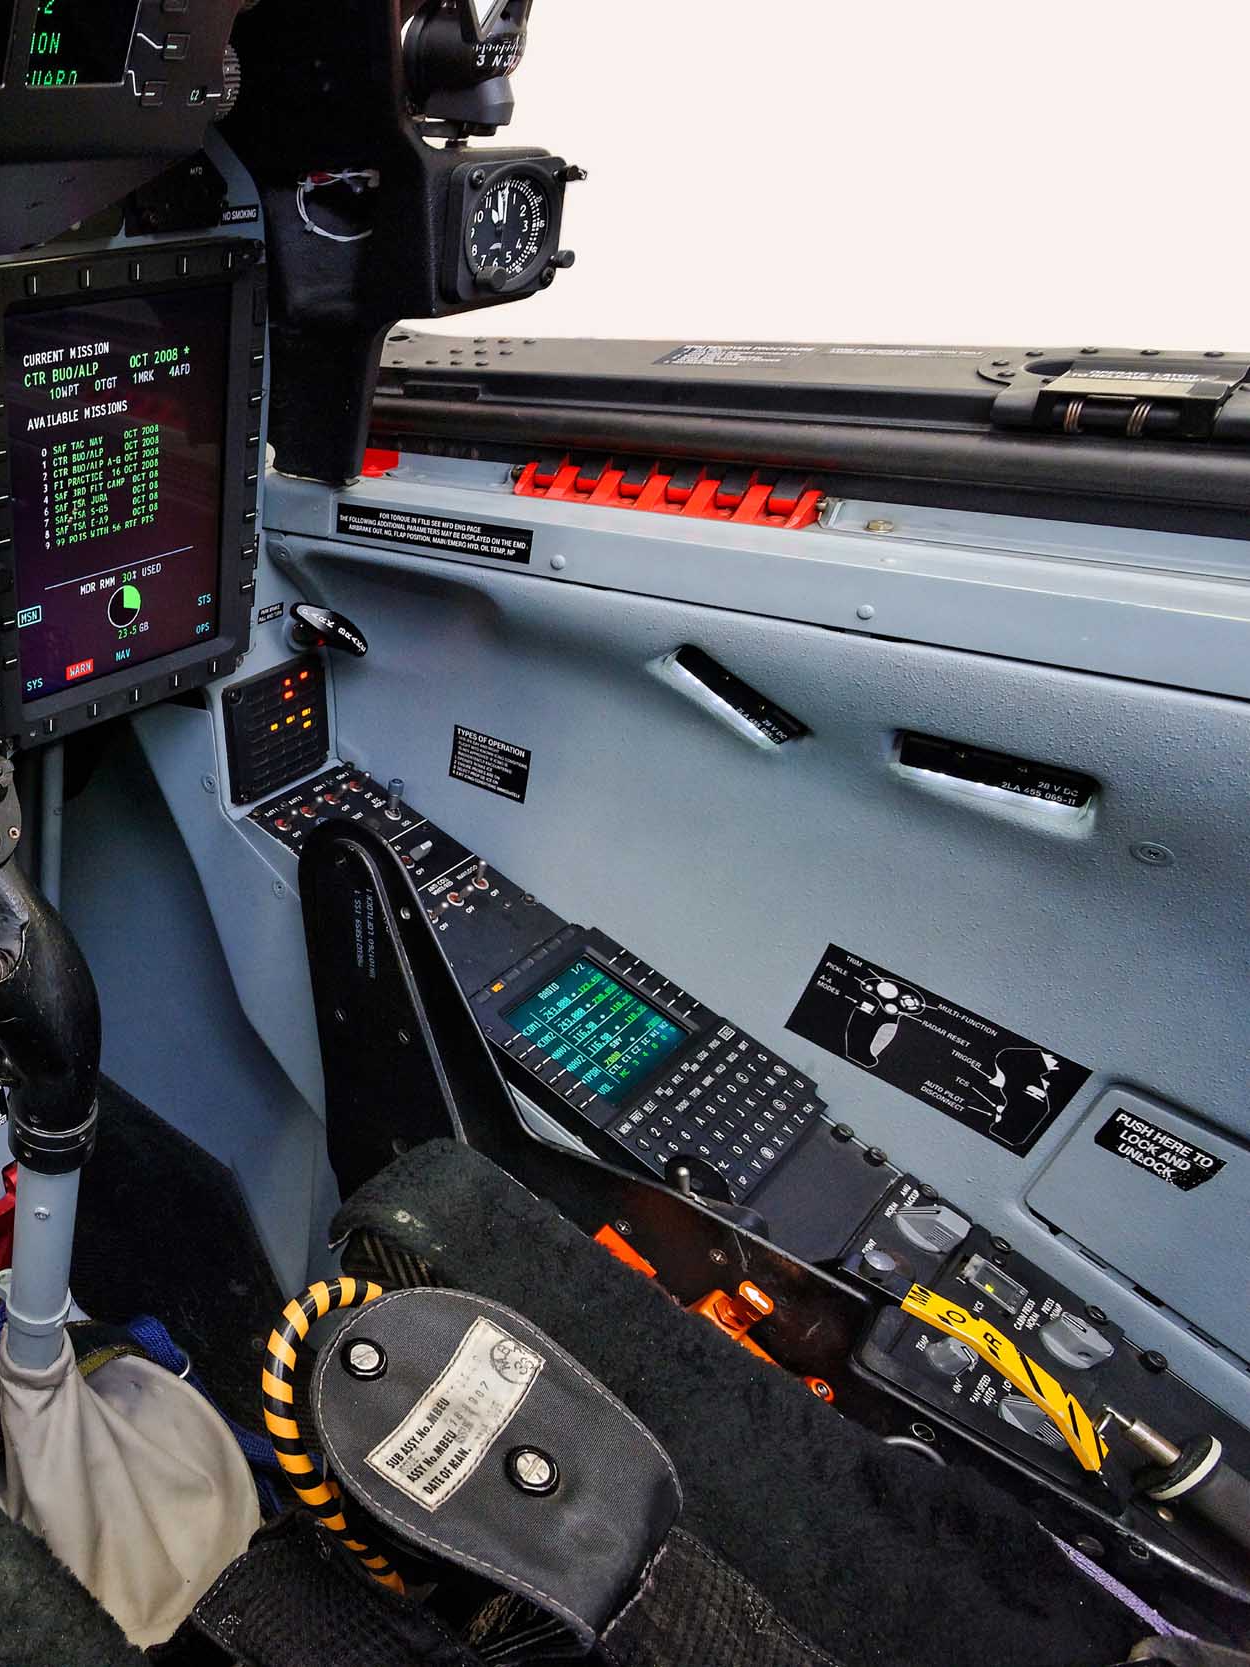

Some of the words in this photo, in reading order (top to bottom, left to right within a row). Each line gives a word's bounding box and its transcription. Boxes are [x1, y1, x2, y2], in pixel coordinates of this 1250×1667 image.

[223, 212, 231, 220] NO
[232, 209, 256, 219] SMOKING
[23, 349, 64, 367] CURRENT
[70, 342, 109, 359] MISSION
[24, 372, 45, 387] CTR
[52, 362, 99, 383] BUO/ALP
[129, 354, 148, 368] OCT
[154, 348, 178, 364] 2008
[27, 410, 79, 431] AVAILABLE
[84, 400, 128, 418] MISSIONS
[53, 445, 67, 454] SAF
[71, 440, 84, 450] TAC
[89, 436, 103, 446] NAV
[124, 429, 138, 439] OCT
[142, 425, 159, 435] 2008
[349, 516, 376, 526] FOLLOWING
[377, 520, 406, 530] ADDITIONAL
[407, 525, 440, 535] PARAMETERS
[461, 533, 491, 544] DISPLAYED
[492, 537, 500, 545] ON
[502, 539, 511, 547] THE
[391, 514, 410, 523] TORQUE
[467, 525, 481, 533] PAGE
[80, 583, 96, 595] MDR
[100, 577, 115, 589] RMM
[142, 563, 162, 577] USED
[198, 594, 211, 605] STS
[21, 610, 38, 622] MSN
[118, 625, 137, 639] 23.5
[139, 622, 149, 632] GB
[196, 622, 209, 634] OPS
[302, 609, 334, 628] PARK
[338, 627, 366, 652] BRAKE
[116, 649, 131, 661] NAV
[69, 662, 91, 677] WARN
[27, 678, 43, 690] SYS
[457, 728, 477, 740] TYPES
[488, 739, 525, 757] OPERATION
[1002, 782, 1020, 792] 2LA
[1024, 788, 1041, 796] 455
[1063, 788, 1078, 796] DC
[826, 962, 848, 976] PICKLE
[846, 956, 863, 967] TRIM
[538, 982, 560, 1000] RADIO
[571, 963, 585, 975] 1/2
[819, 974, 832, 983] A-A
[817, 981, 840, 995] MODES
[938, 1004, 997, 1036] MULTI-FUNCTION
[923, 1020, 946, 1036] RADAR
[947, 1033, 970, 1047] RESET
[951, 1050, 982, 1068] TRIGGER
[955, 1076, 969, 1087] TCS
[921, 1086, 965, 1111] DISCONNECT
[925, 1080, 944, 1093] AUTO
[945, 1090, 965, 1103] PILOT
[1116, 1113, 1154, 1137] PUSH
[1153, 1132, 1193, 1157] HERE
[1193, 1153, 1213, 1168] TO
[1119, 1130, 1160, 1156] LOCK
[1158, 1152, 1191, 1170] AND
[1118, 1143, 1176, 1179] UNLOCK
[885, 1202, 899, 1218] NORM
[916, 1335, 929, 1351] TEMP
[969, 1391, 980, 1403] FAN
[978, 1375, 991, 1394] SPEED
[983, 1388, 996, 1406] AUTO
[386, 1454, 404, 1469] SUB
[407, 1465, 426, 1483] ASSY
[423, 1475, 445, 1495] DATE
[441, 1466, 452, 1480] OF
[450, 1449, 472, 1471] MAN.
